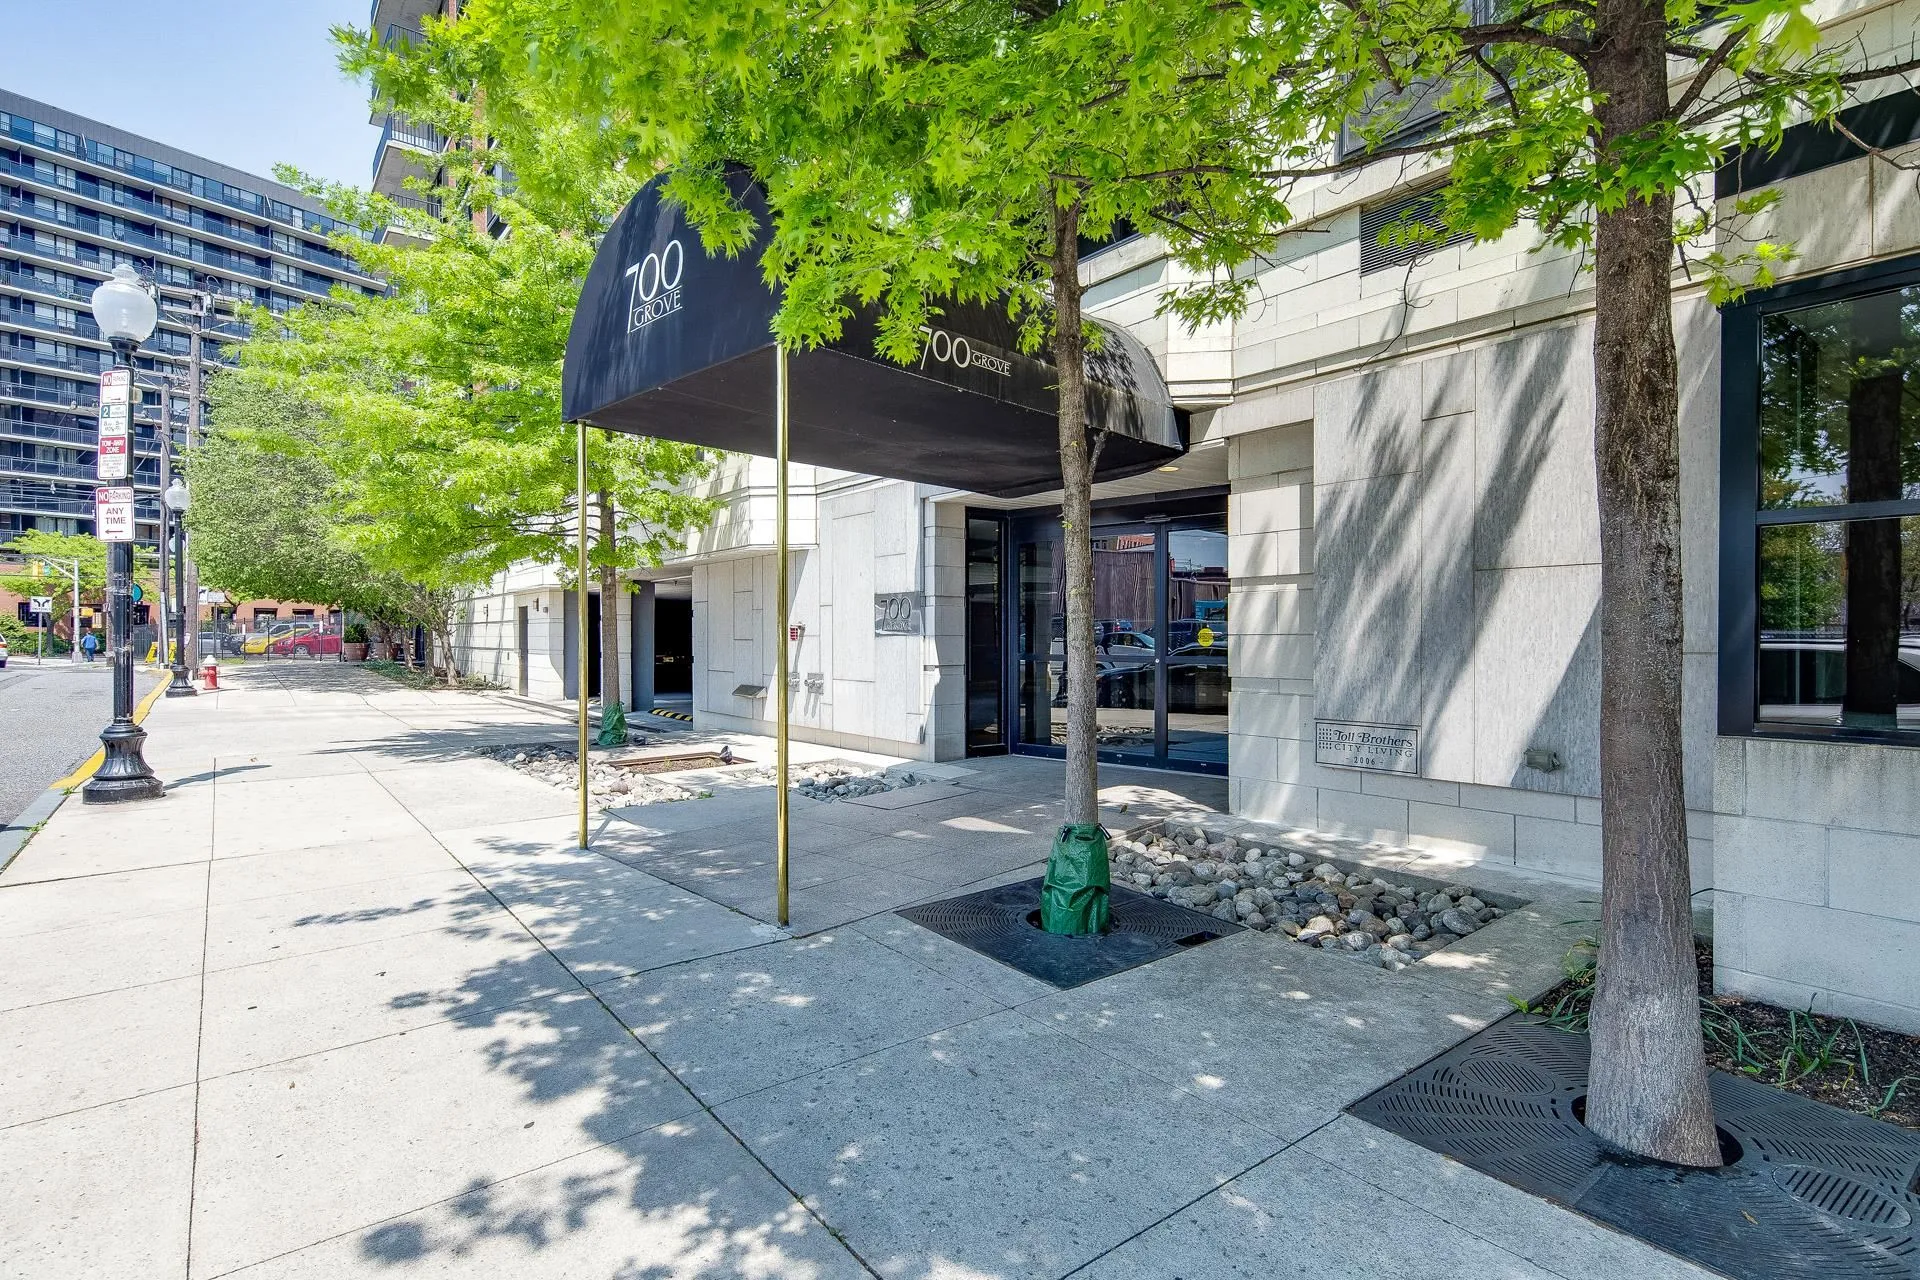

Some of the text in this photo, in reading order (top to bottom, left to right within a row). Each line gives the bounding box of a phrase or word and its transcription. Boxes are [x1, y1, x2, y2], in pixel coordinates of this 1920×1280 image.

[625, 239, 684, 334] 700
[633, 290, 681, 326] GROVE
[919, 325, 1010, 375] 700 GROVE
[103, 374, 112, 385] NO
[103, 406, 109, 416] 2
[105, 446, 120, 454] ZONE
[98, 490, 131, 502] NO PARKING
[105, 507, 124, 515] ANY
[105, 516, 127, 525] TIME
[880, 598, 911, 631] 700
[1333, 729, 1413, 748] Toll Brothers
[1334, 743, 1413, 758] CITY LIVING
[1353, 756, 1376, 766] 2006
